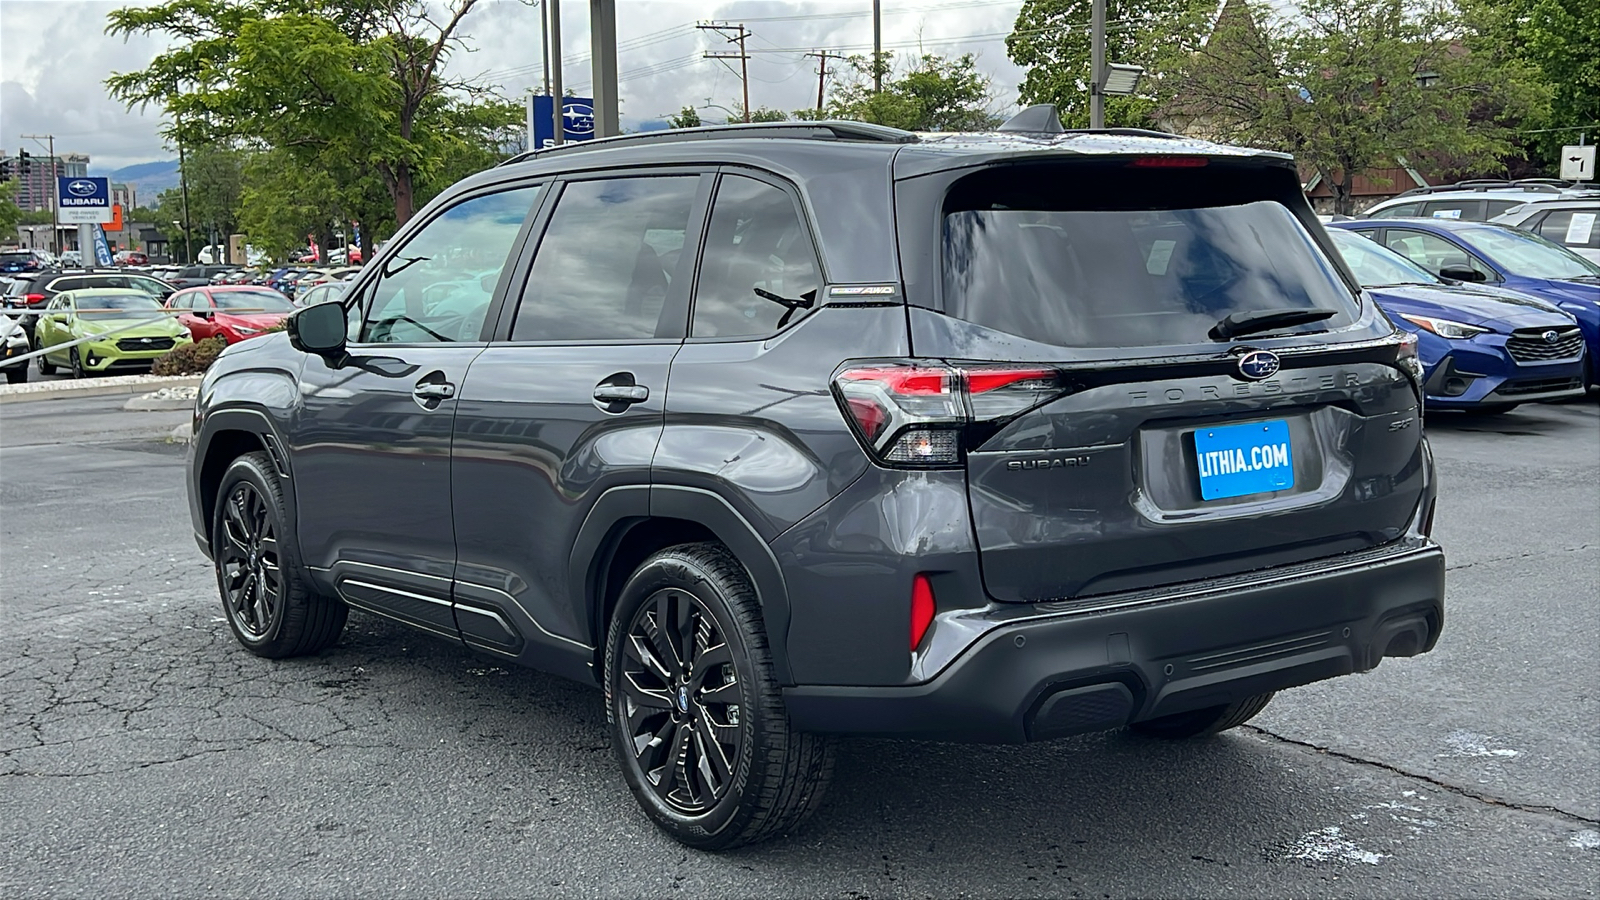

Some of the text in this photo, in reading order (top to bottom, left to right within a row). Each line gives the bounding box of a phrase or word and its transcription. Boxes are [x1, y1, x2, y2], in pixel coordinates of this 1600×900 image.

[62, 198, 105, 206] SUBARU
[1128, 372, 1360, 401] FORESTER
[1006, 456, 1091, 471] SUBARU
[1198, 442, 1289, 478] LITHIA.COM
[604, 616, 620, 725] BRIDGESTONE
[735, 674, 755, 797] BRIDGESTONE
